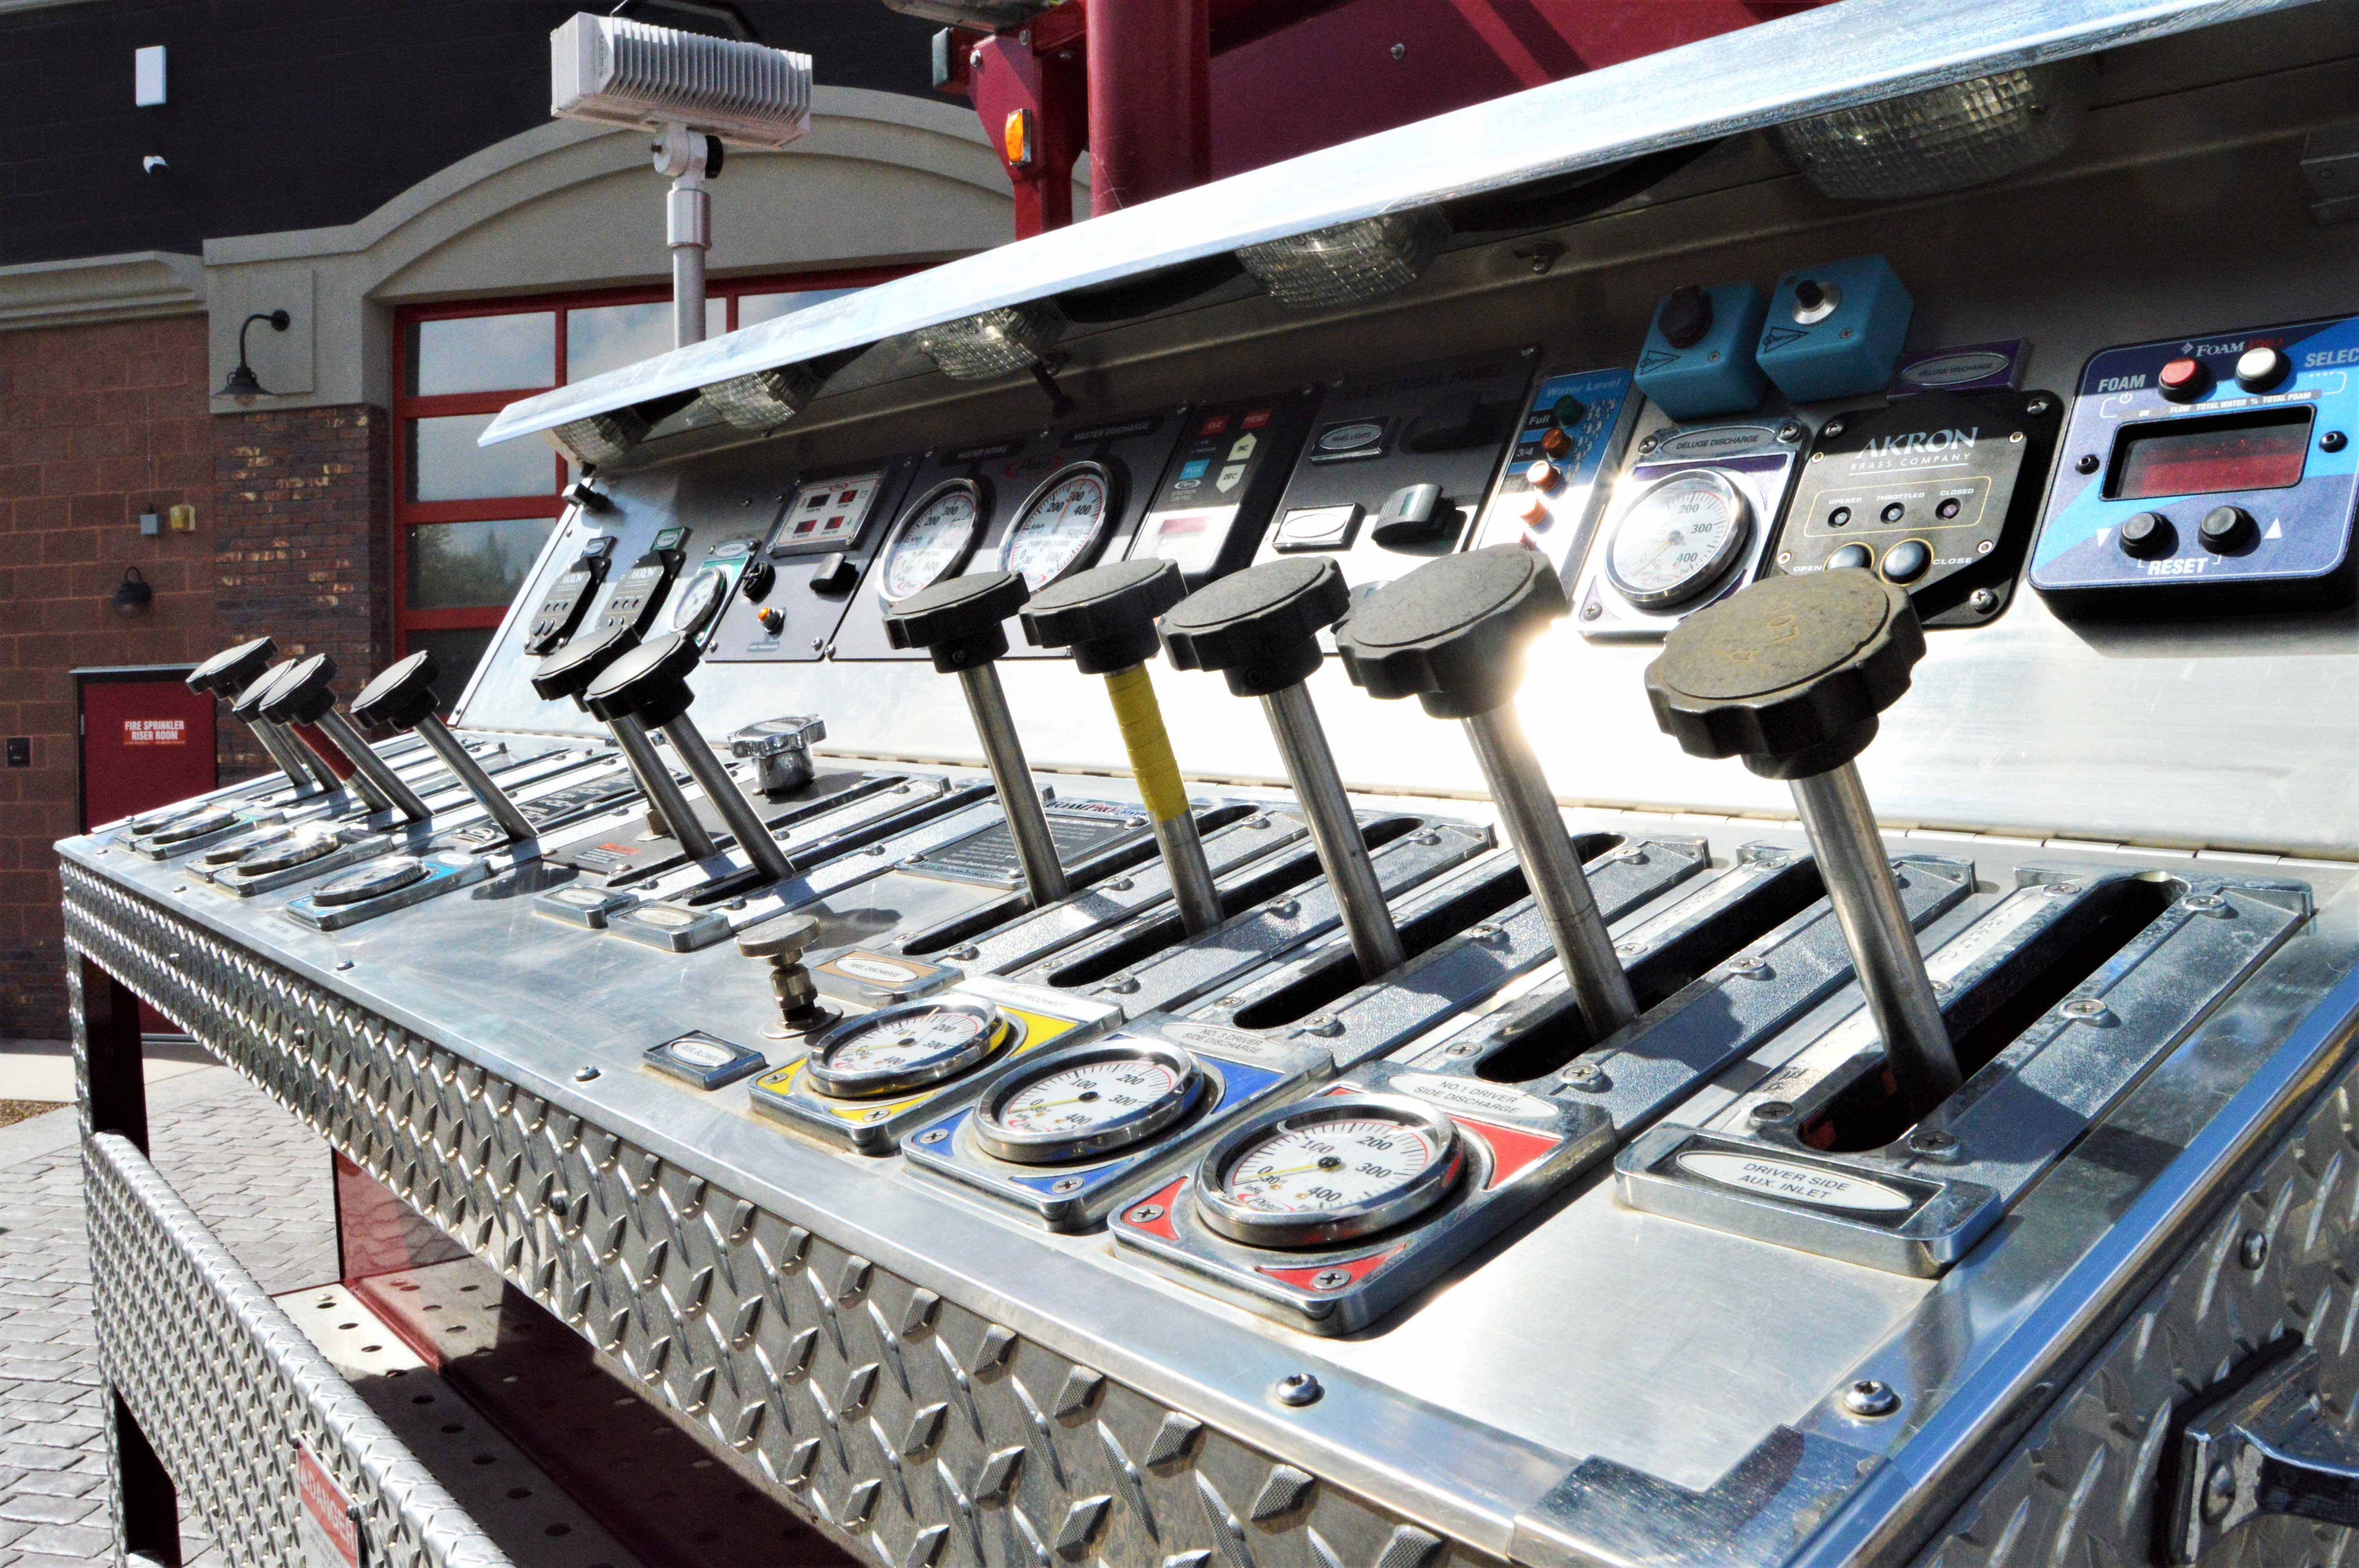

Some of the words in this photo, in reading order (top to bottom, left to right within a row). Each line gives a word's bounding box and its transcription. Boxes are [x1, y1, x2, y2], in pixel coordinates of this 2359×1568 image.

[2196, 342, 2244, 357] FOAM
[1587, 377, 1622, 391] Level
[2098, 374, 2146, 392] FOAM
[2263, 395, 2286, 403] TOTAL
[2287, 392, 2311, 401] FOAM
[2170, 405, 2190, 413] FLOW
[2196, 402, 2220, 410] TOTAL
[2221, 399, 2246, 408] WATER
[1530, 415, 1550, 425] Full
[1105, 422, 1150, 435] DISCHARGE
[1676, 439, 1710, 450] DELUGE
[1710, 435, 1759, 446] DISCHARGE
[1855, 427, 1978, 459] AKRON
[1517, 447, 1534, 457] 3/4
[1851, 460, 1892, 470] BRASS
[1900, 452, 1971, 466] COMPANY
[1876, 492, 1925, 501] THROTTLED
[1046, 502, 1065, 512] 200
[1074, 504, 1092, 515] 400
[1678, 503, 1699, 514] 200
[1690, 523, 1713, 534] 300
[1676, 552, 1697, 563] 400
[2148, 558, 2208, 575] RESET
[629, 569, 655, 579] AKRON
[125, 720, 142, 730] FIRE
[144, 720, 184, 730] SPRINKLER
[132, 730, 153, 740] RISER
[155, 730, 178, 740] ROOM
[933, 1024, 957, 1033] 200
[922, 1040, 946, 1049] 300
[1183, 1033, 1205, 1042] SIDE
[1205, 1038, 1263, 1054] DISCHARGE
[1225, 1034, 1263, 1046] DRIVER
[1069, 1078, 1098, 1089] 100
[1115, 1074, 1145, 1085] 200
[1108, 1094, 1138, 1106] 300
[1414, 1086, 1445, 1097] SIDE
[1444, 1093, 1519, 1113] DISCHARGE
[1469, 1089, 1518, 1103] DRIVER
[1065, 1113, 1092, 1125] 400
[1299, 1139, 1335, 1154] 100
[1354, 1136, 1394, 1151] 200
[1355, 1162, 1392, 1178] 300
[1743, 1163, 1807, 1181] DRIVER
[1808, 1177, 1851, 1191] SIDE
[1738, 1175, 1774, 1188] AUX.
[1779, 1183, 1832, 1199] INLET
[1307, 1186, 1343, 1202] 400
[308, 1469, 355, 1554] DANGER
